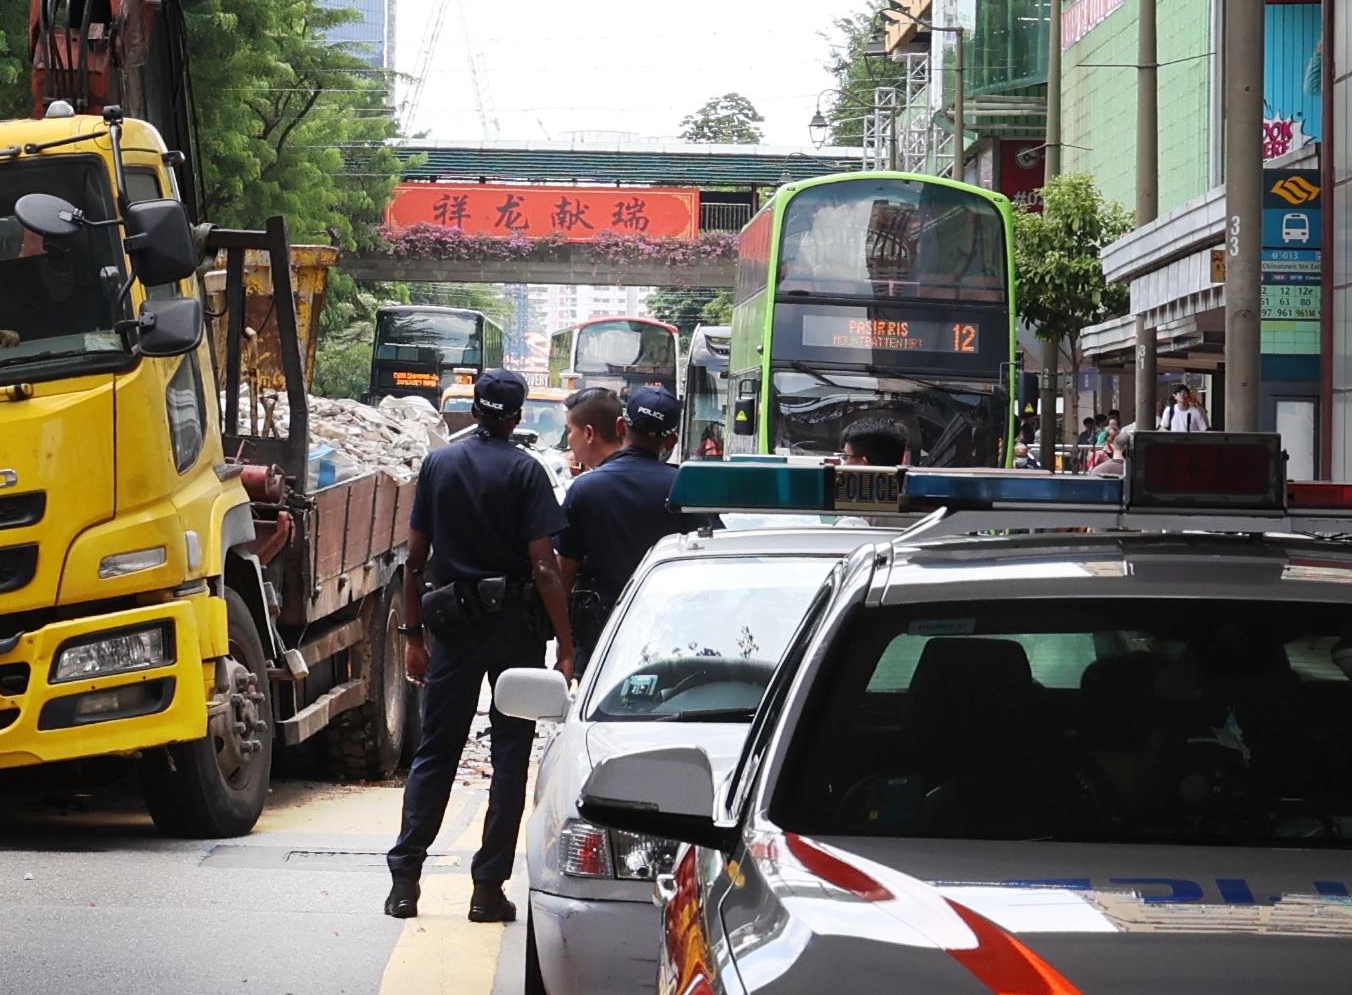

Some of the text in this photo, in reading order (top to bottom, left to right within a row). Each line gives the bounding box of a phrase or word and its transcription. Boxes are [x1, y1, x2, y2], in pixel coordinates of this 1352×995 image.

[1262, 121, 1293, 142] OOK
[1263, 140, 1290, 159] ERE
[433, 193, 650, 231] 祥龙献瑞
[1280, 287, 1290, 295] 12
[1298, 287, 1313, 295] 12e
[1279, 298, 1290, 306] 63
[1300, 298, 1311, 307] 80
[1277, 308, 1292, 317] 961
[1295, 308, 1315, 318] 961M
[952, 323, 978, 352] 12
[480, 398, 504, 411] POLICE
[637, 406, 665, 421] POLICE
